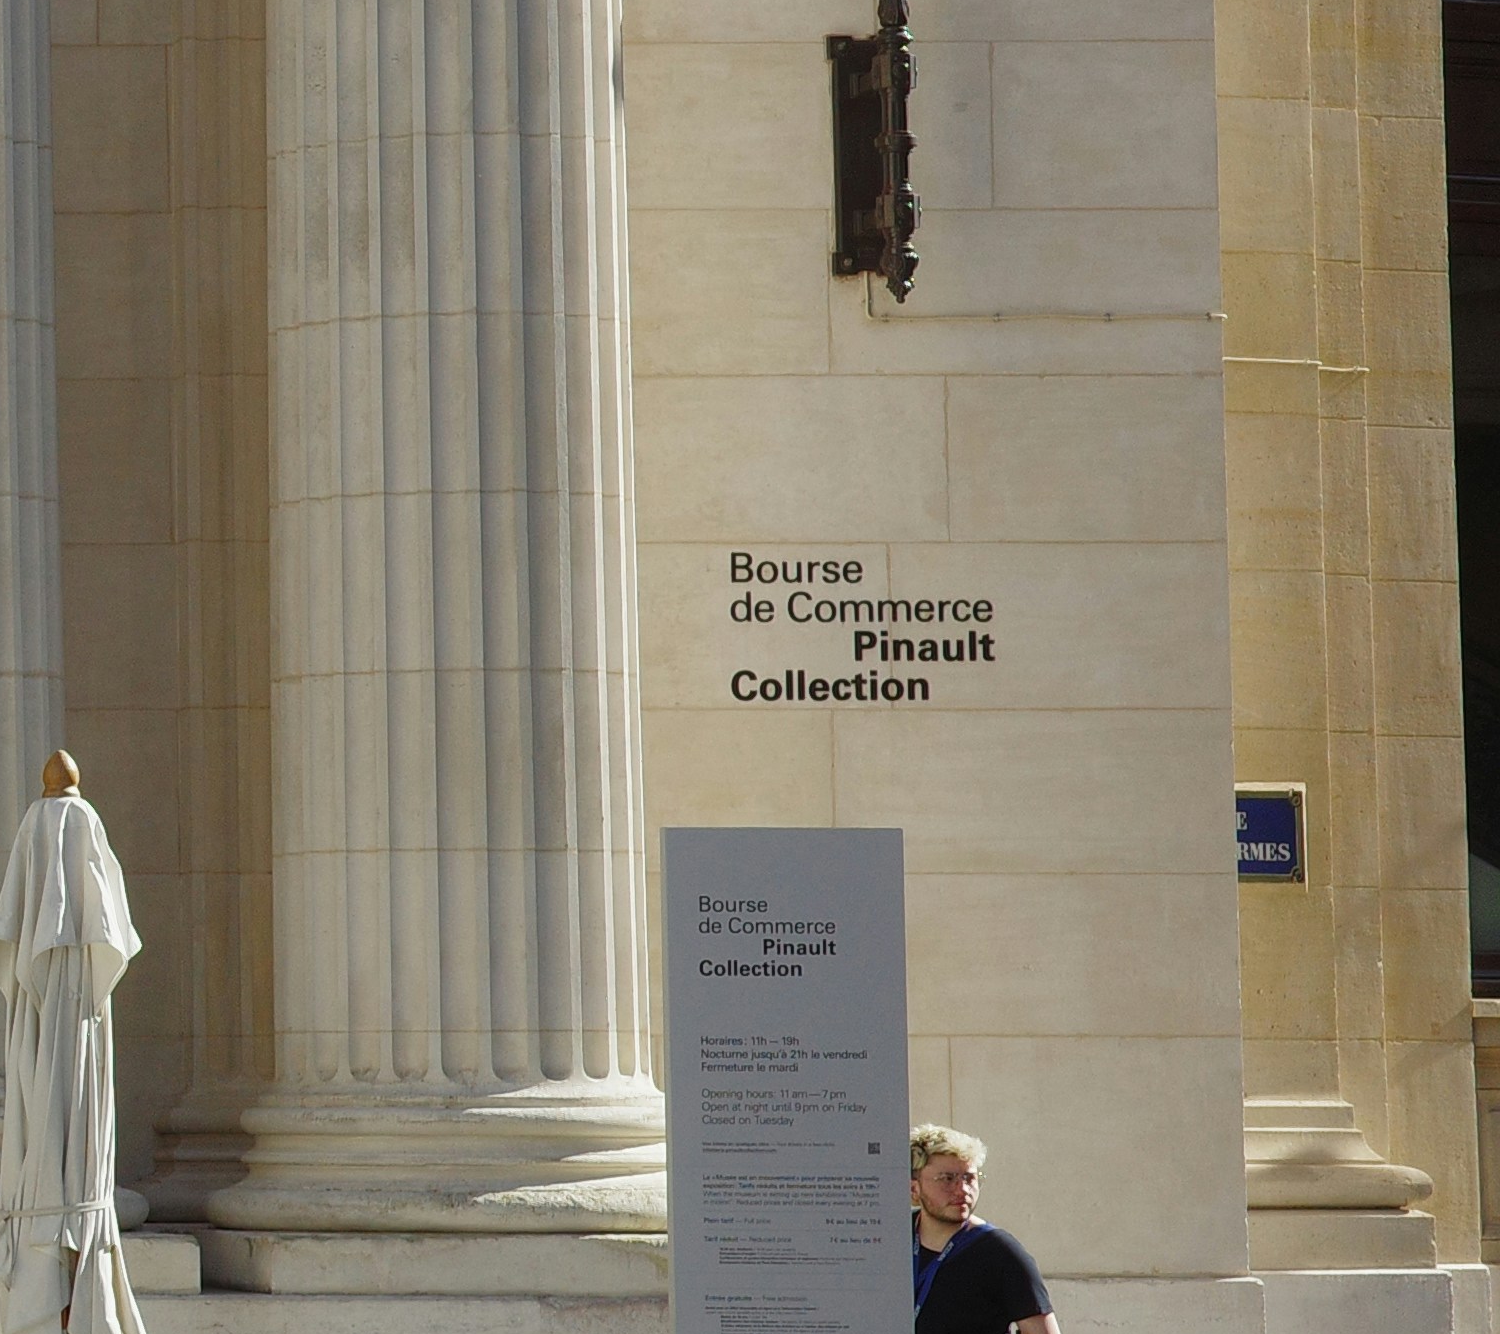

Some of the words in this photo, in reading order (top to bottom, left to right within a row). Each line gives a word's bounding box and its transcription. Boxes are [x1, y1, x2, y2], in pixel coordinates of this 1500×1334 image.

[730, 552, 863, 584] Bourse
[730, 591, 775, 623] de
[787, 591, 993, 623] Commerce
[854, 631, 995, 662] Pinault
[731, 670, 930, 702] Collection
[698, 895, 768, 913] Bourse
[698, 917, 722, 934] de
[728, 917, 836, 935] Commerce
[763, 939, 837, 956] Pinault
[699, 960, 803, 977] Collection
[751, 1035, 767, 1046] 11h
[782, 1035, 799, 1046] 19h
[701, 1049, 749, 1059] Nocturne
[790, 1049, 808, 1059] 21h
[811, 1049, 820, 1059] le
[822, 1050, 868, 1060] vendredi
[701, 1062, 754, 1072] Fermeture
[757, 1062, 766, 1072] le
[768, 1063, 799, 1073] mardi
[701, 1088, 743, 1100] Opening
[701, 1101, 729, 1113] Open
[731, 1103, 741, 1112] at
[744, 1103, 768, 1113] night
[771, 1103, 792, 1112] until
[821, 1104, 835, 1112] on
[838, 1103, 867, 1114] Friday
[702, 1114, 736, 1124] Closed
[738, 1116, 751, 1124] on
[755, 1115, 795, 1126] Tuesday
